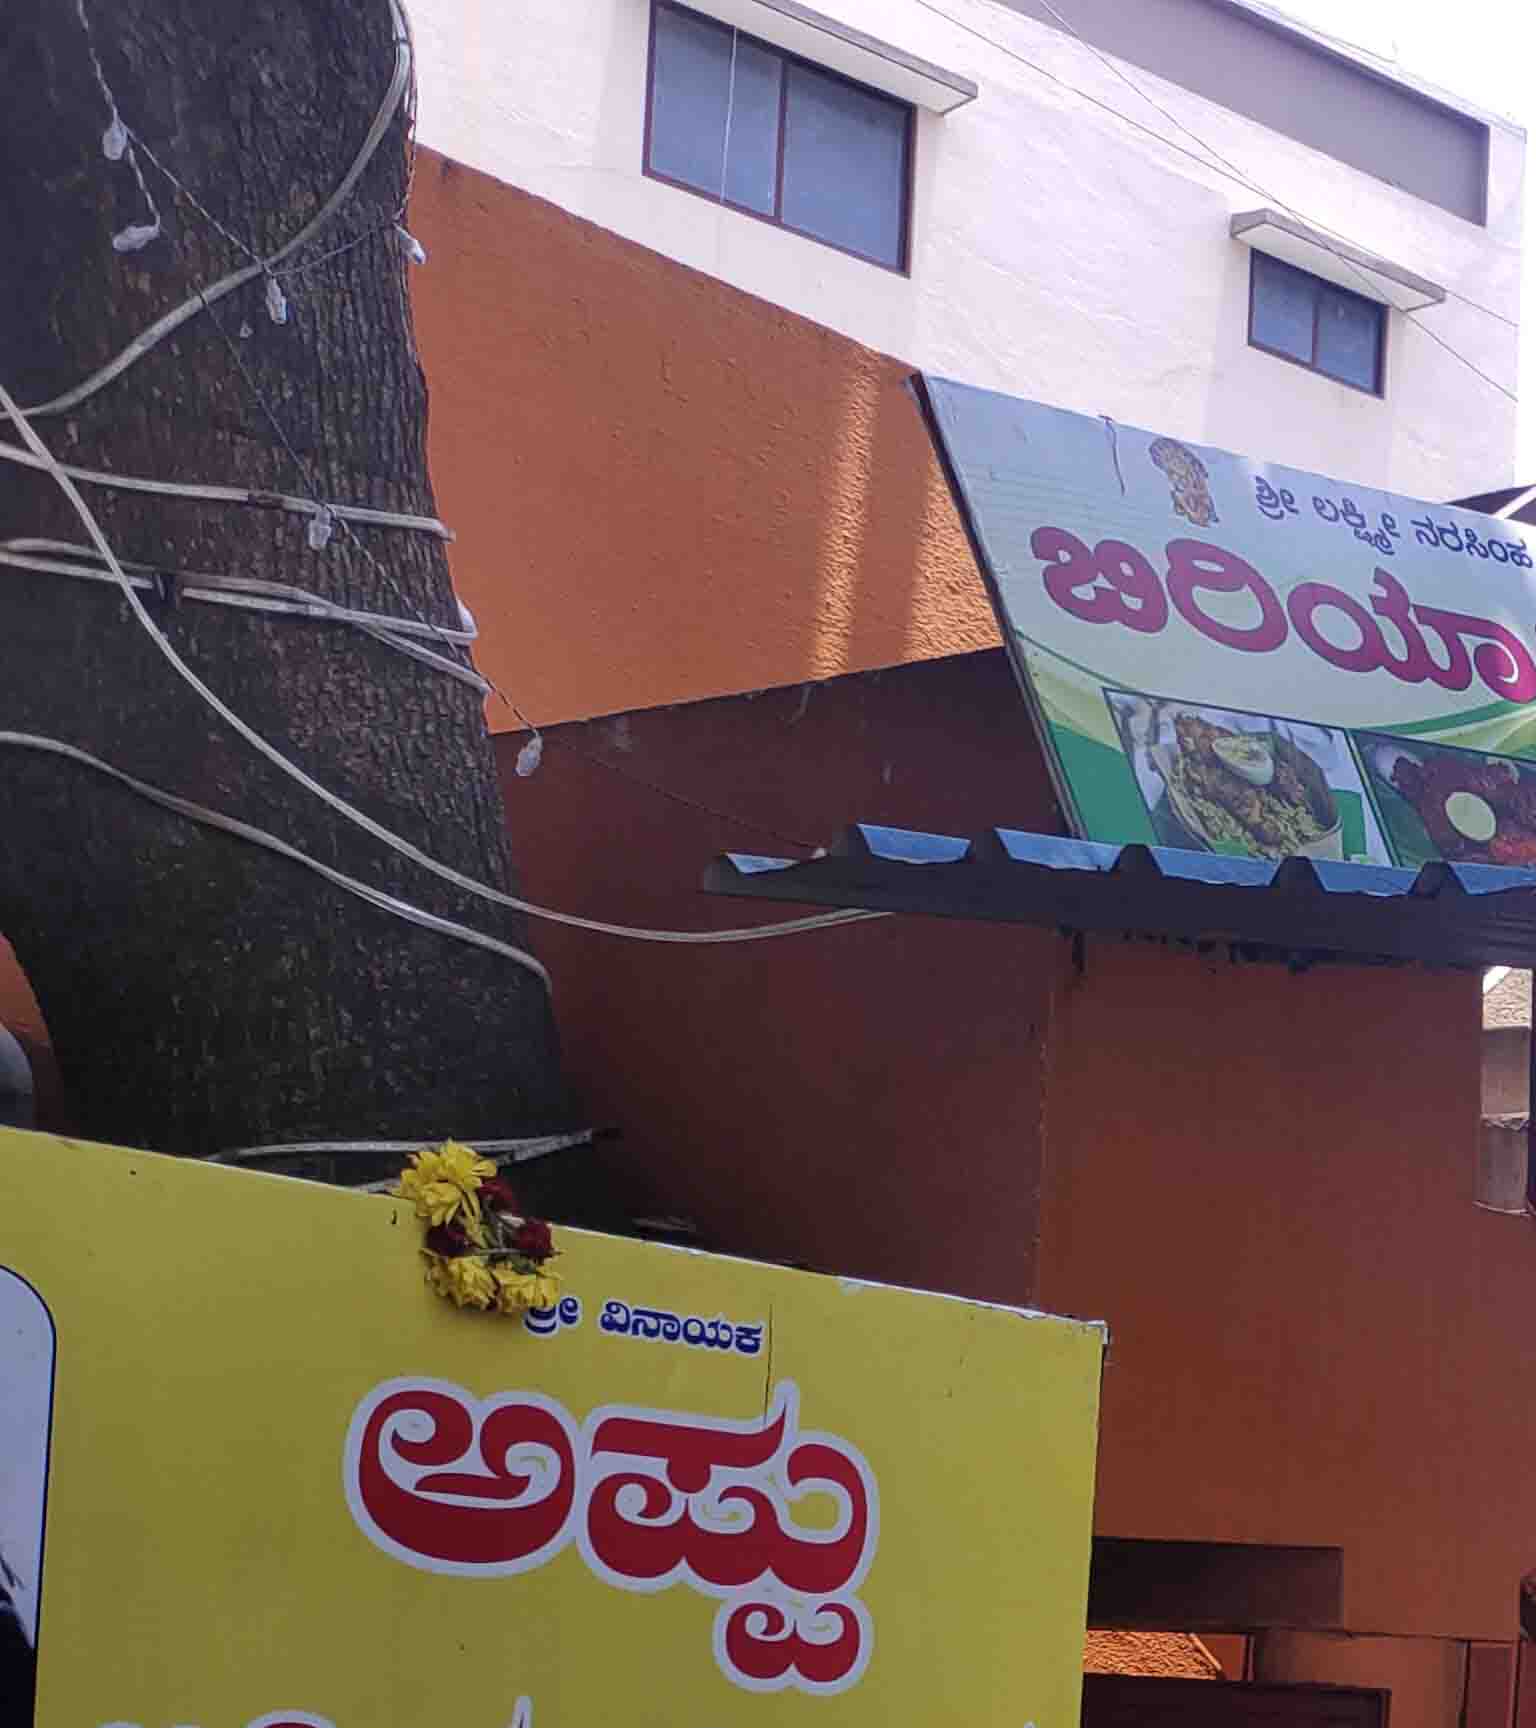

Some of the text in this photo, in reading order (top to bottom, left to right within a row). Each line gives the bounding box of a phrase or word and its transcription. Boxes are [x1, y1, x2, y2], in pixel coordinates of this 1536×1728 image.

[1255, 476, 1296, 520] ಶ್ರೀ
[1411, 518, 1534, 569] ನರಸಿಂಹ
[601, 1302, 763, 1354] ವಿನಾಯಕ
[344, 1380, 878, 1694] ಅಪ್ಪು
